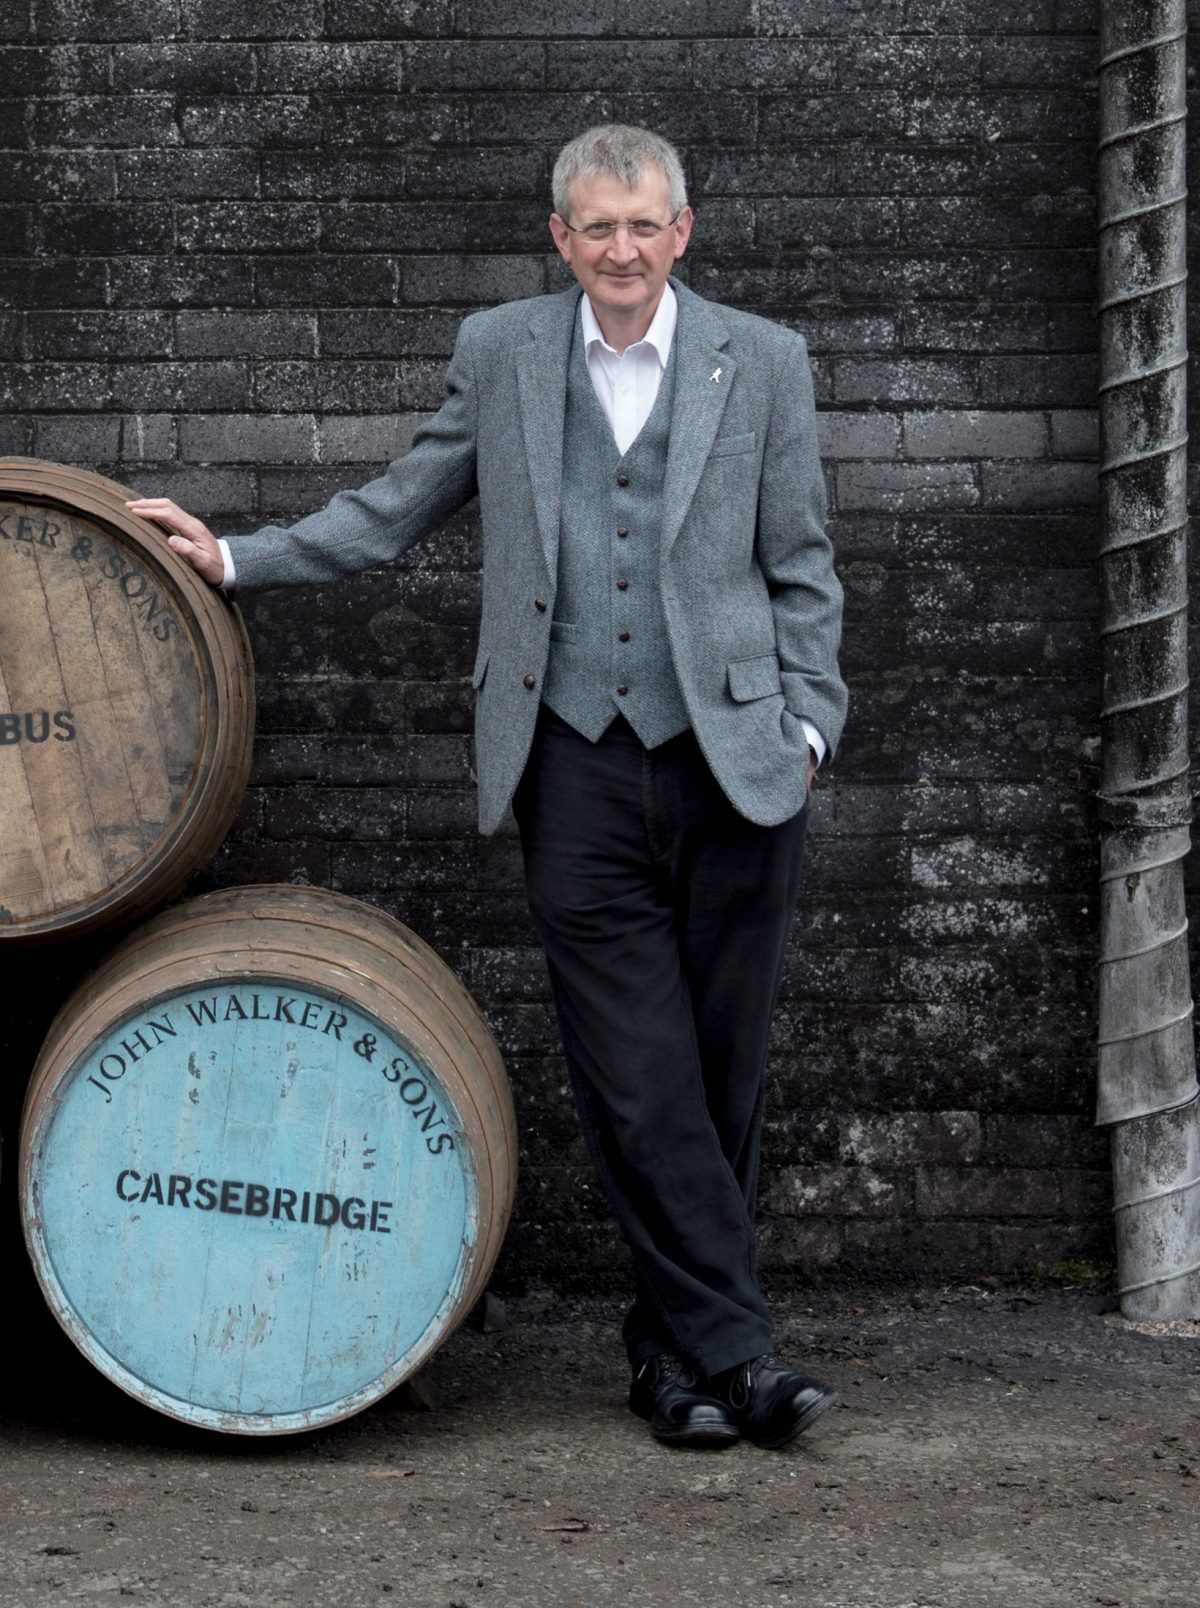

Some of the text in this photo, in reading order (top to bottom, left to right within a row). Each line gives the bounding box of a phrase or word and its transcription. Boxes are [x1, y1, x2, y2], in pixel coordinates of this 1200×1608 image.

[71, 537, 93, 561] &
[101, 554, 180, 642] SONS
[87, 994, 454, 1155] JOHN WALKER & SONS
[116, 1170, 393, 1233] CARSEBRIDGE
